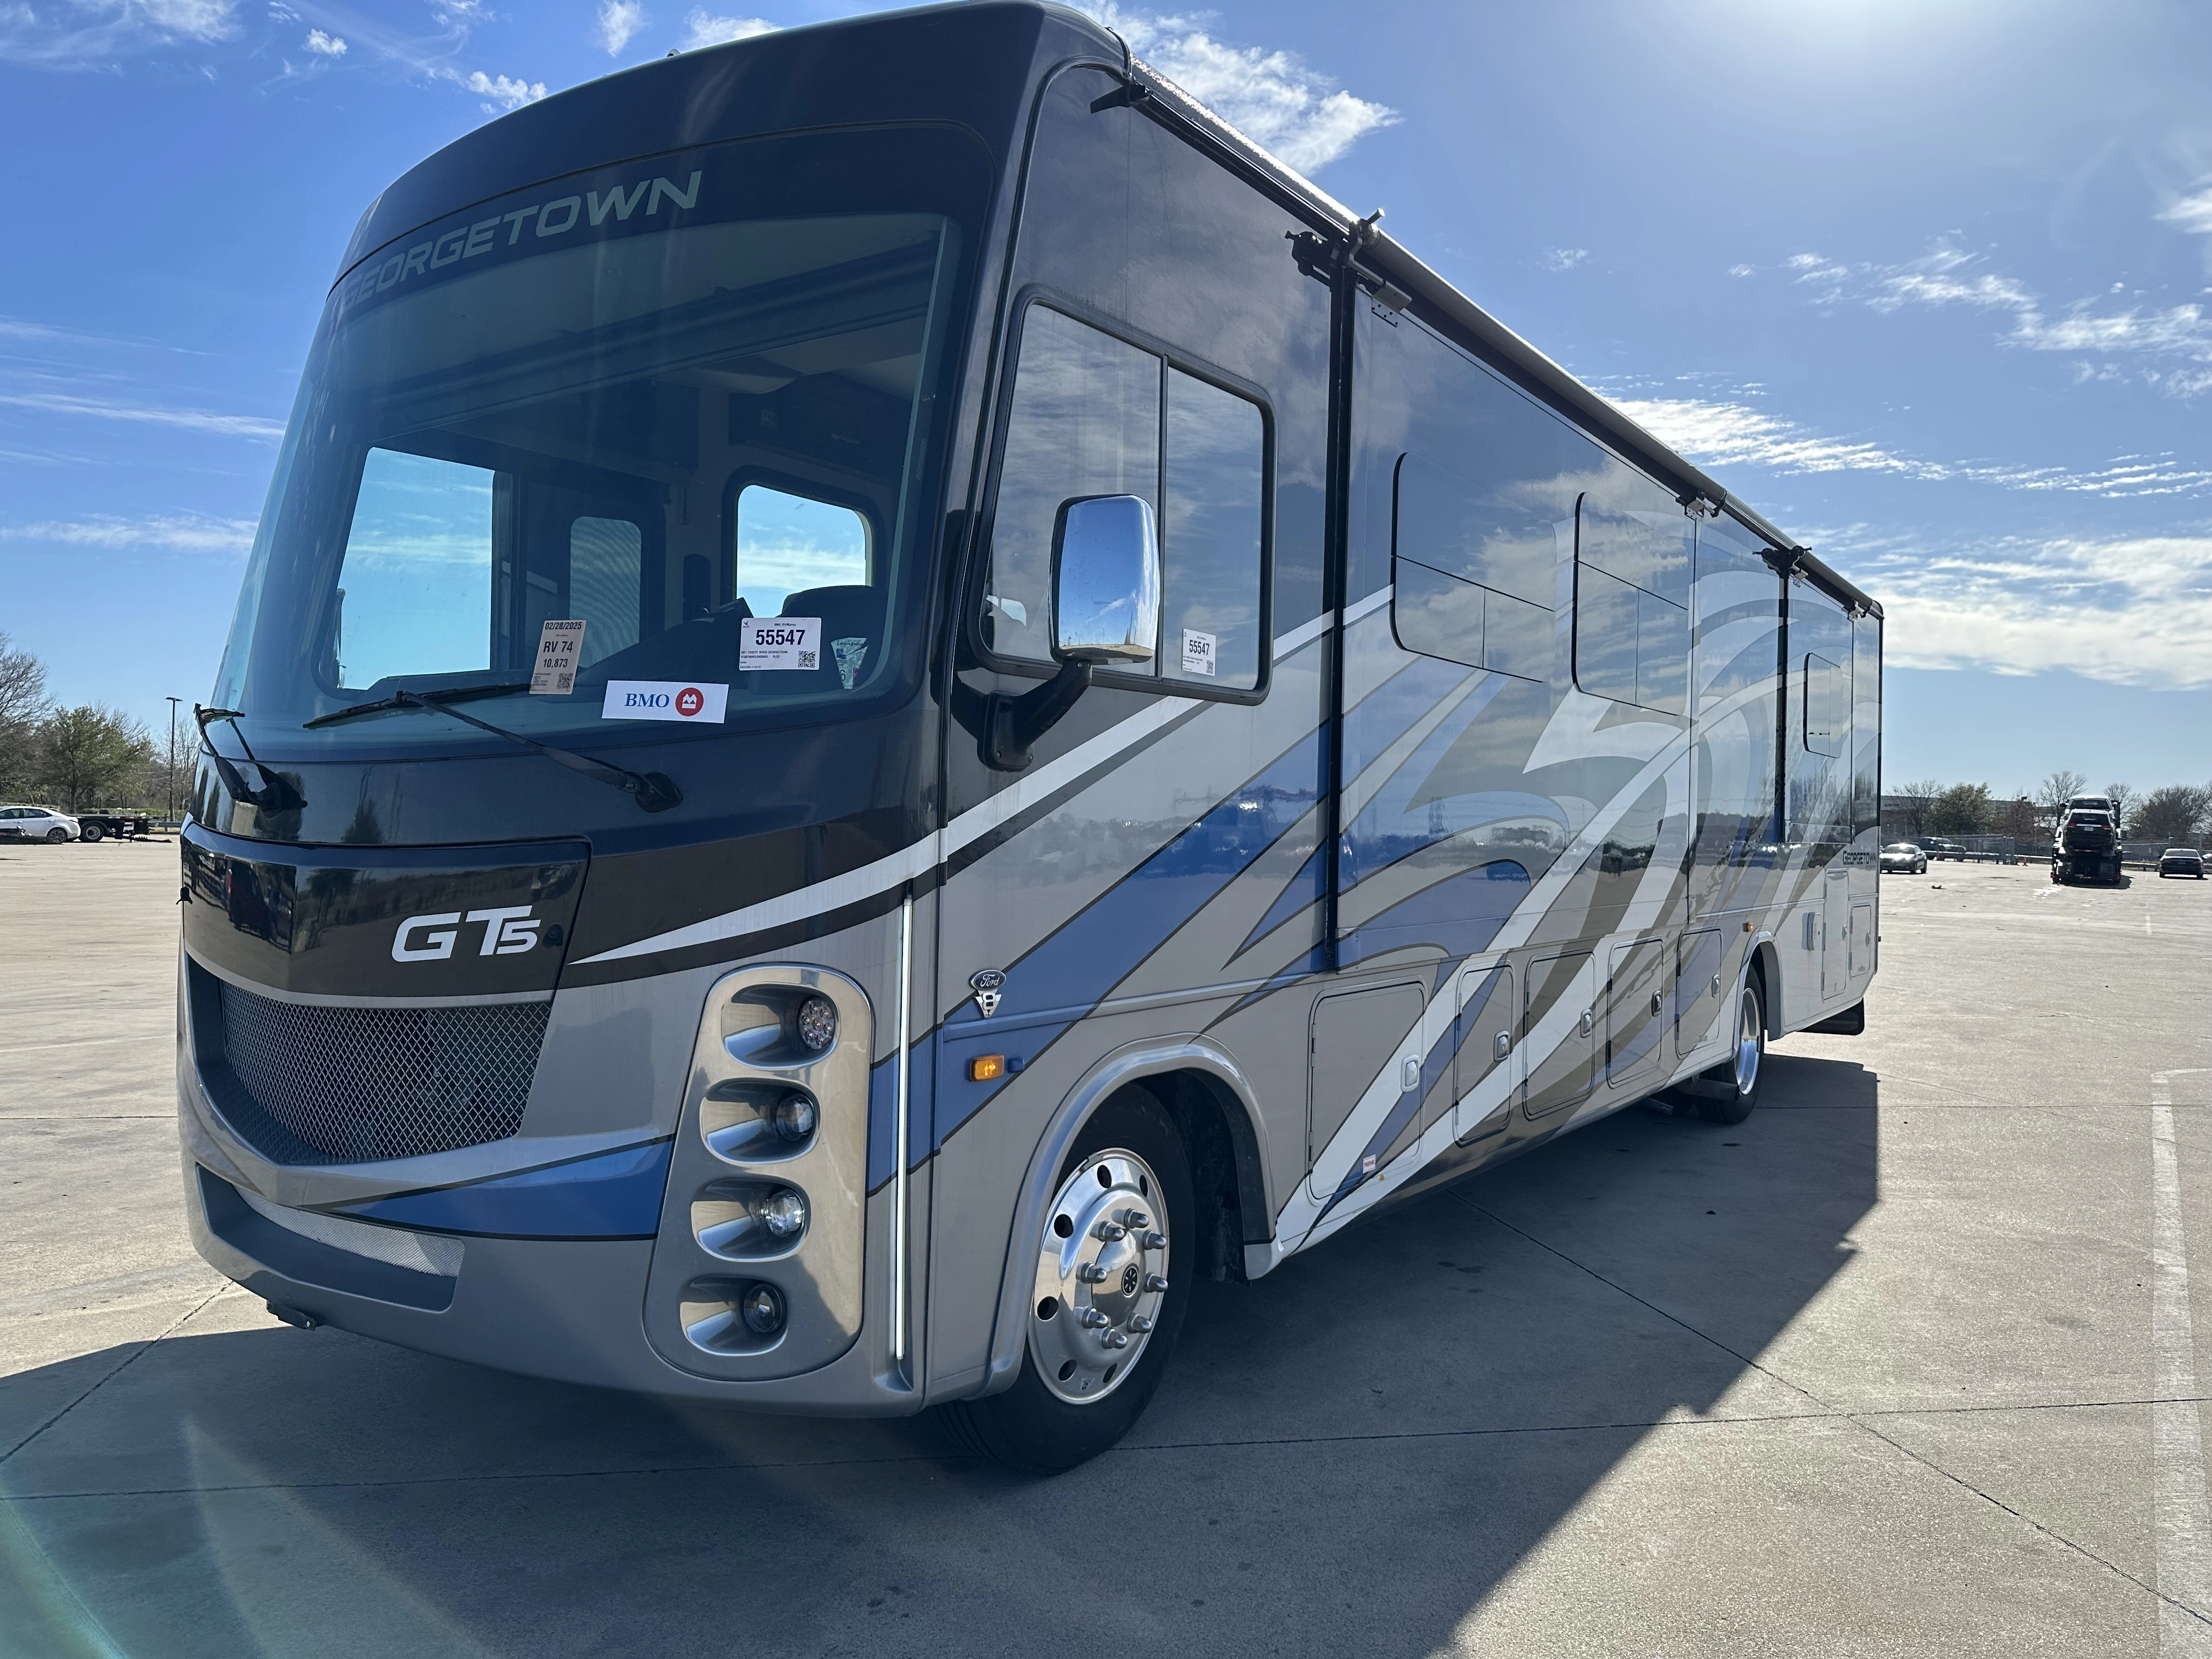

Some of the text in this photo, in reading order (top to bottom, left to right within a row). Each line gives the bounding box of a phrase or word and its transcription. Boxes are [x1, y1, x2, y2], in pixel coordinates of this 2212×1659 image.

[342, 170, 702, 309] GEORGETOWN
[545, 622, 582, 630] 02/28/2025
[755, 629, 805, 645] 55547
[543, 641, 573, 653] RV 74
[1189, 639, 1210, 656] 55547
[543, 658, 568, 669] 10,873
[624, 693, 670, 708] BMO
[1842, 850, 1877, 865] GEORGETOWN
[392, 905, 541, 962] GT5
[980, 974, 1000, 988] Ford
